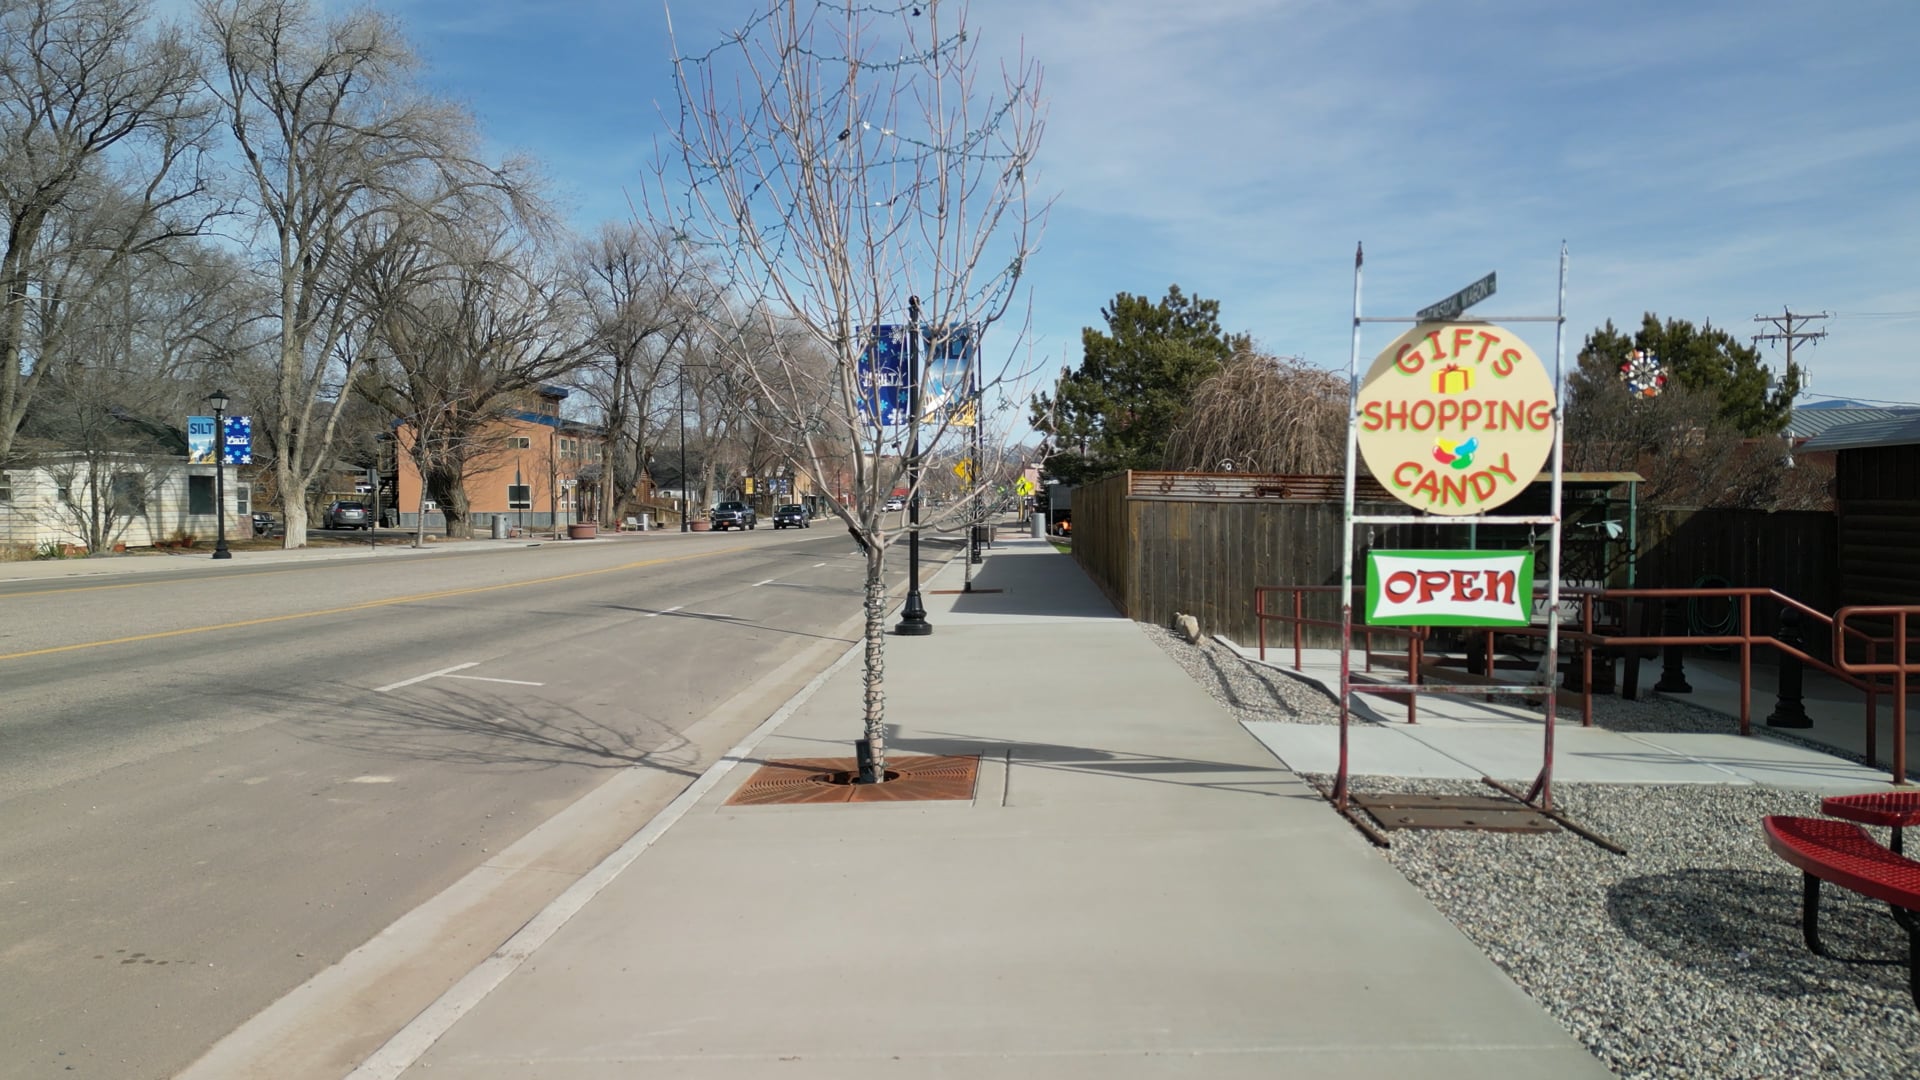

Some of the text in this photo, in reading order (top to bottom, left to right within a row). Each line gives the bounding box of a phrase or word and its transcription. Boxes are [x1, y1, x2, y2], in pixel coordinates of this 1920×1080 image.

[1461, 278, 1489, 308] WAGON
[1395, 329, 1522, 376] GIFTS
[190, 423, 214, 434] SILT
[1362, 399, 1551, 431] SHOPPING
[1393, 452, 1517, 505] CANDY
